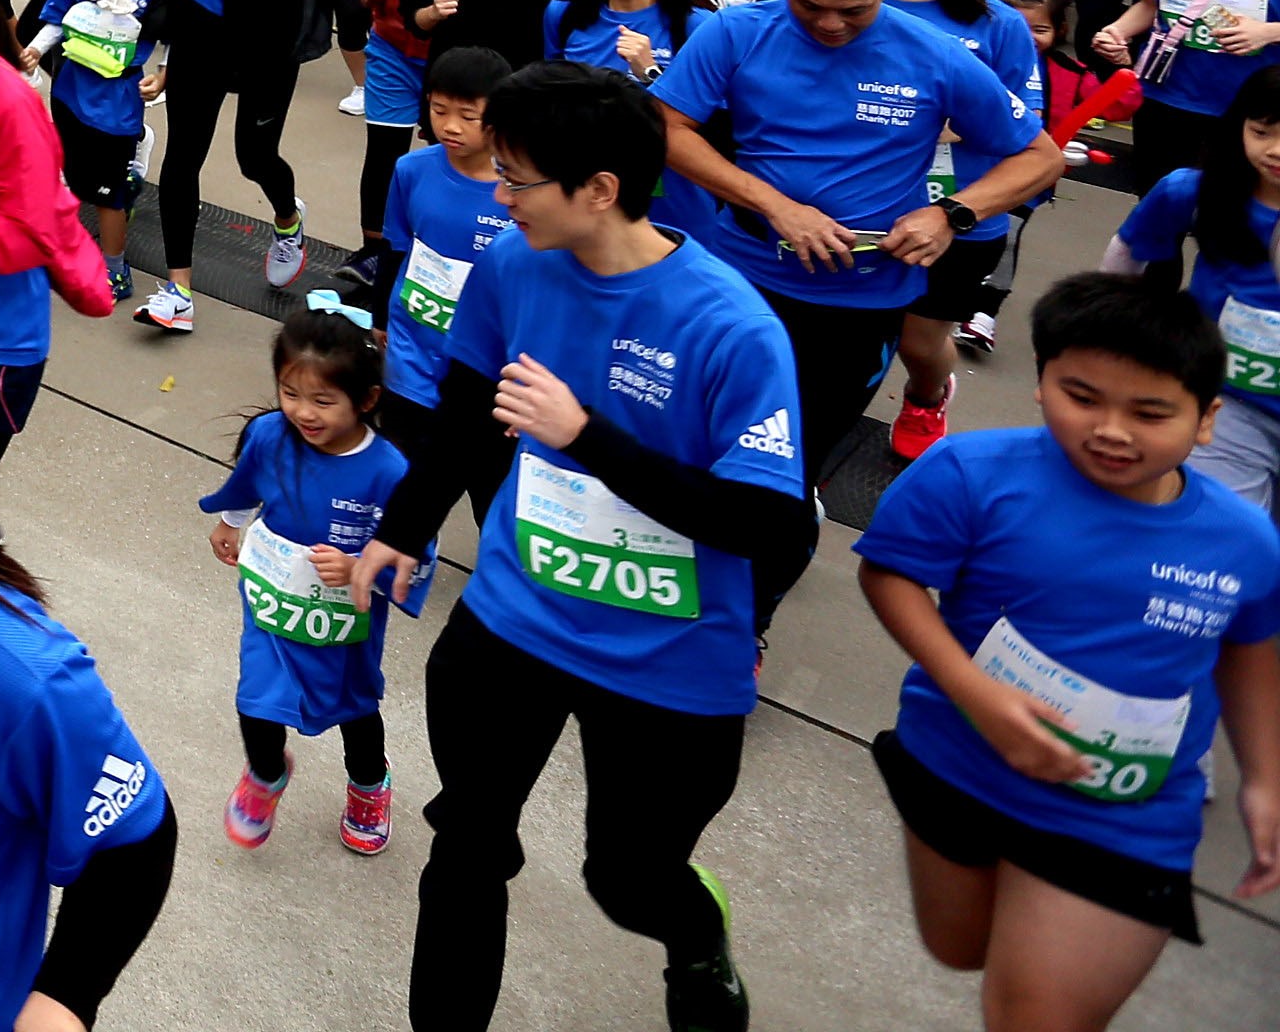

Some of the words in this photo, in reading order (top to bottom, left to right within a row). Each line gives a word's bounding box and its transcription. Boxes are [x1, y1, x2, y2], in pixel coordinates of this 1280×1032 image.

[858, 81, 900, 96] unicef
[856, 113, 889, 126] Charity
[891, 117, 909, 126] Run
[408, 289, 456, 330] F27
[613, 528, 628, 549] 3
[528, 534, 682, 607] F2705
[1151, 561, 1218, 590] unicef
[310, 584, 322, 600] 3
[244, 578, 355, 642] F2707
[83, 760, 146, 837] adidas
